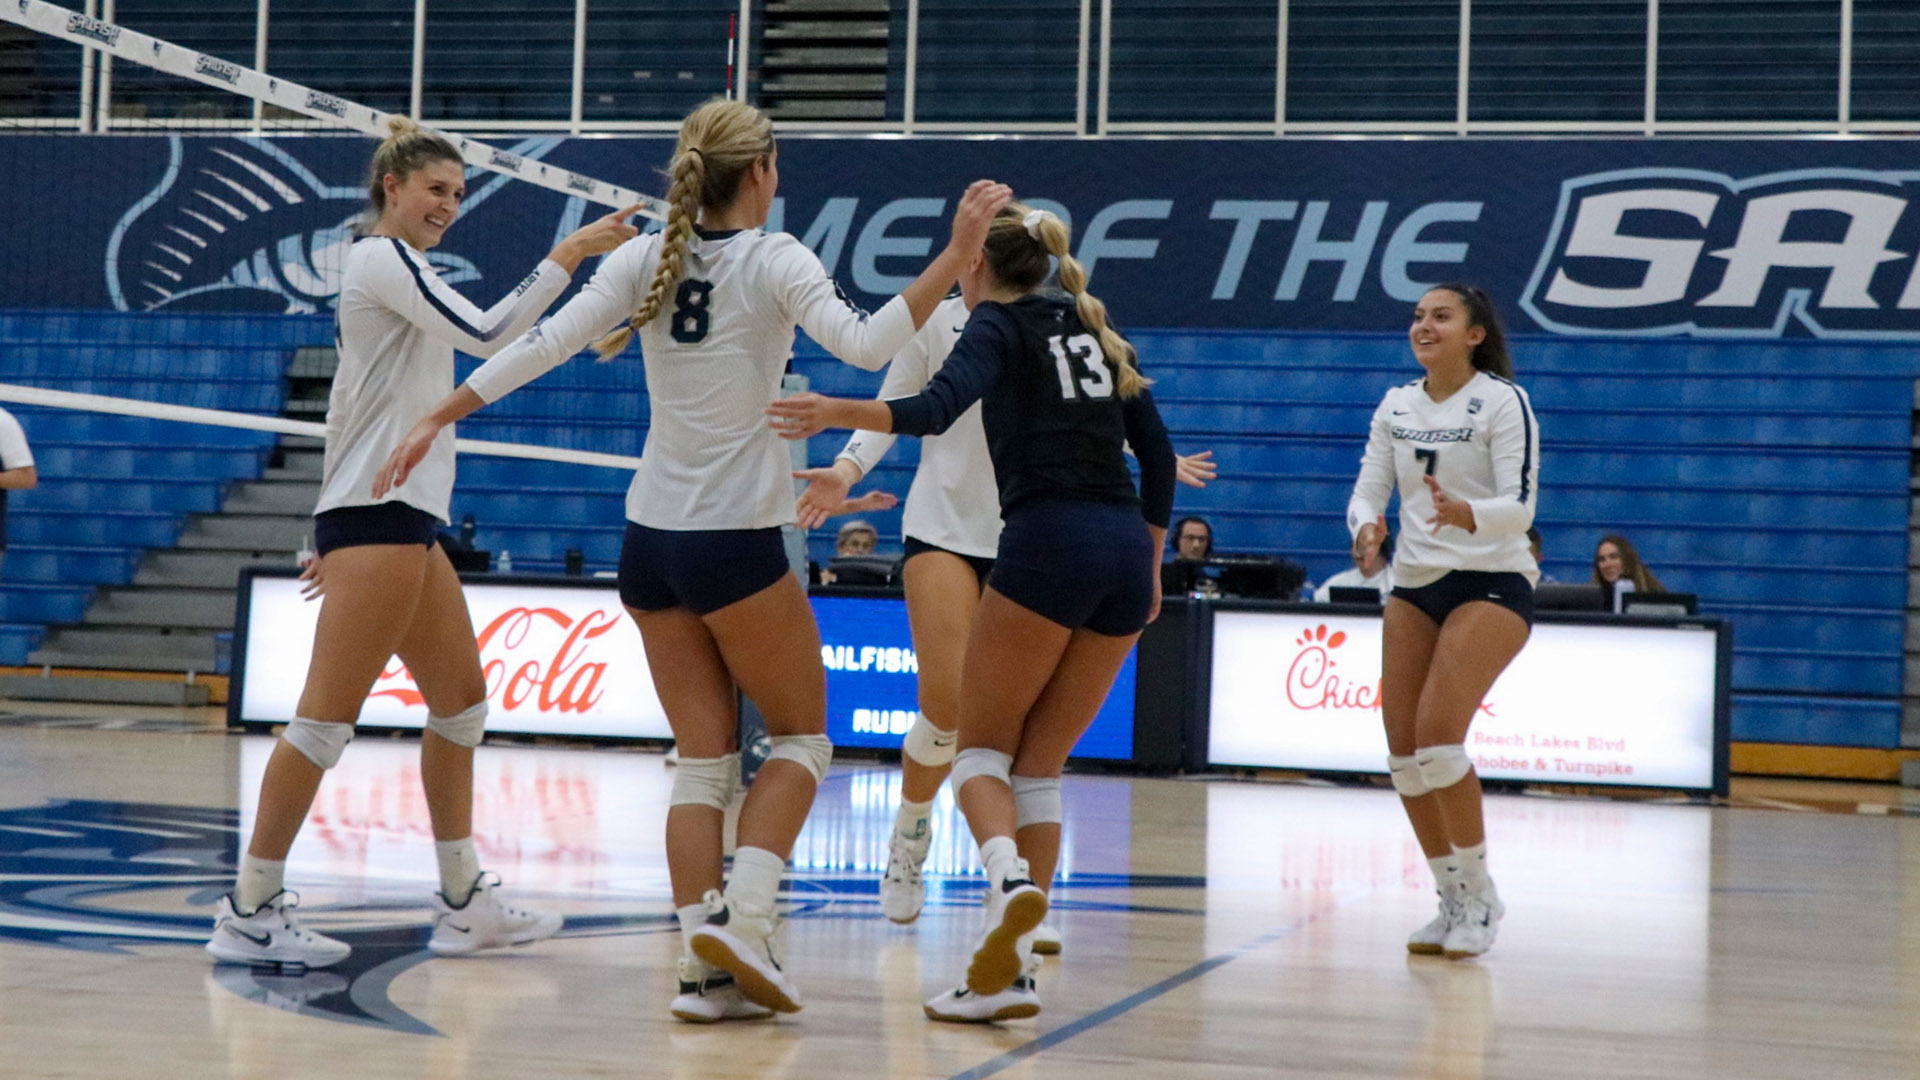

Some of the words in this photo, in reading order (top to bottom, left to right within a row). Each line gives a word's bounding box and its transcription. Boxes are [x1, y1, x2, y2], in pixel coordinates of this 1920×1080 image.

[1208, 200, 1484, 302] THE
[670, 278, 714, 344] 8
[1048, 333, 1113, 399] 13
[1415, 447, 1438, 477] 7
[820, 644, 919, 674] AILFISH
[1474, 732, 1525, 747] Beach
[1531, 734, 1581, 749] Lakes
[1587, 737, 1626, 752] Blvd
[1535, 757, 1548, 772] &
[1554, 758, 1635, 777] Turnpike
